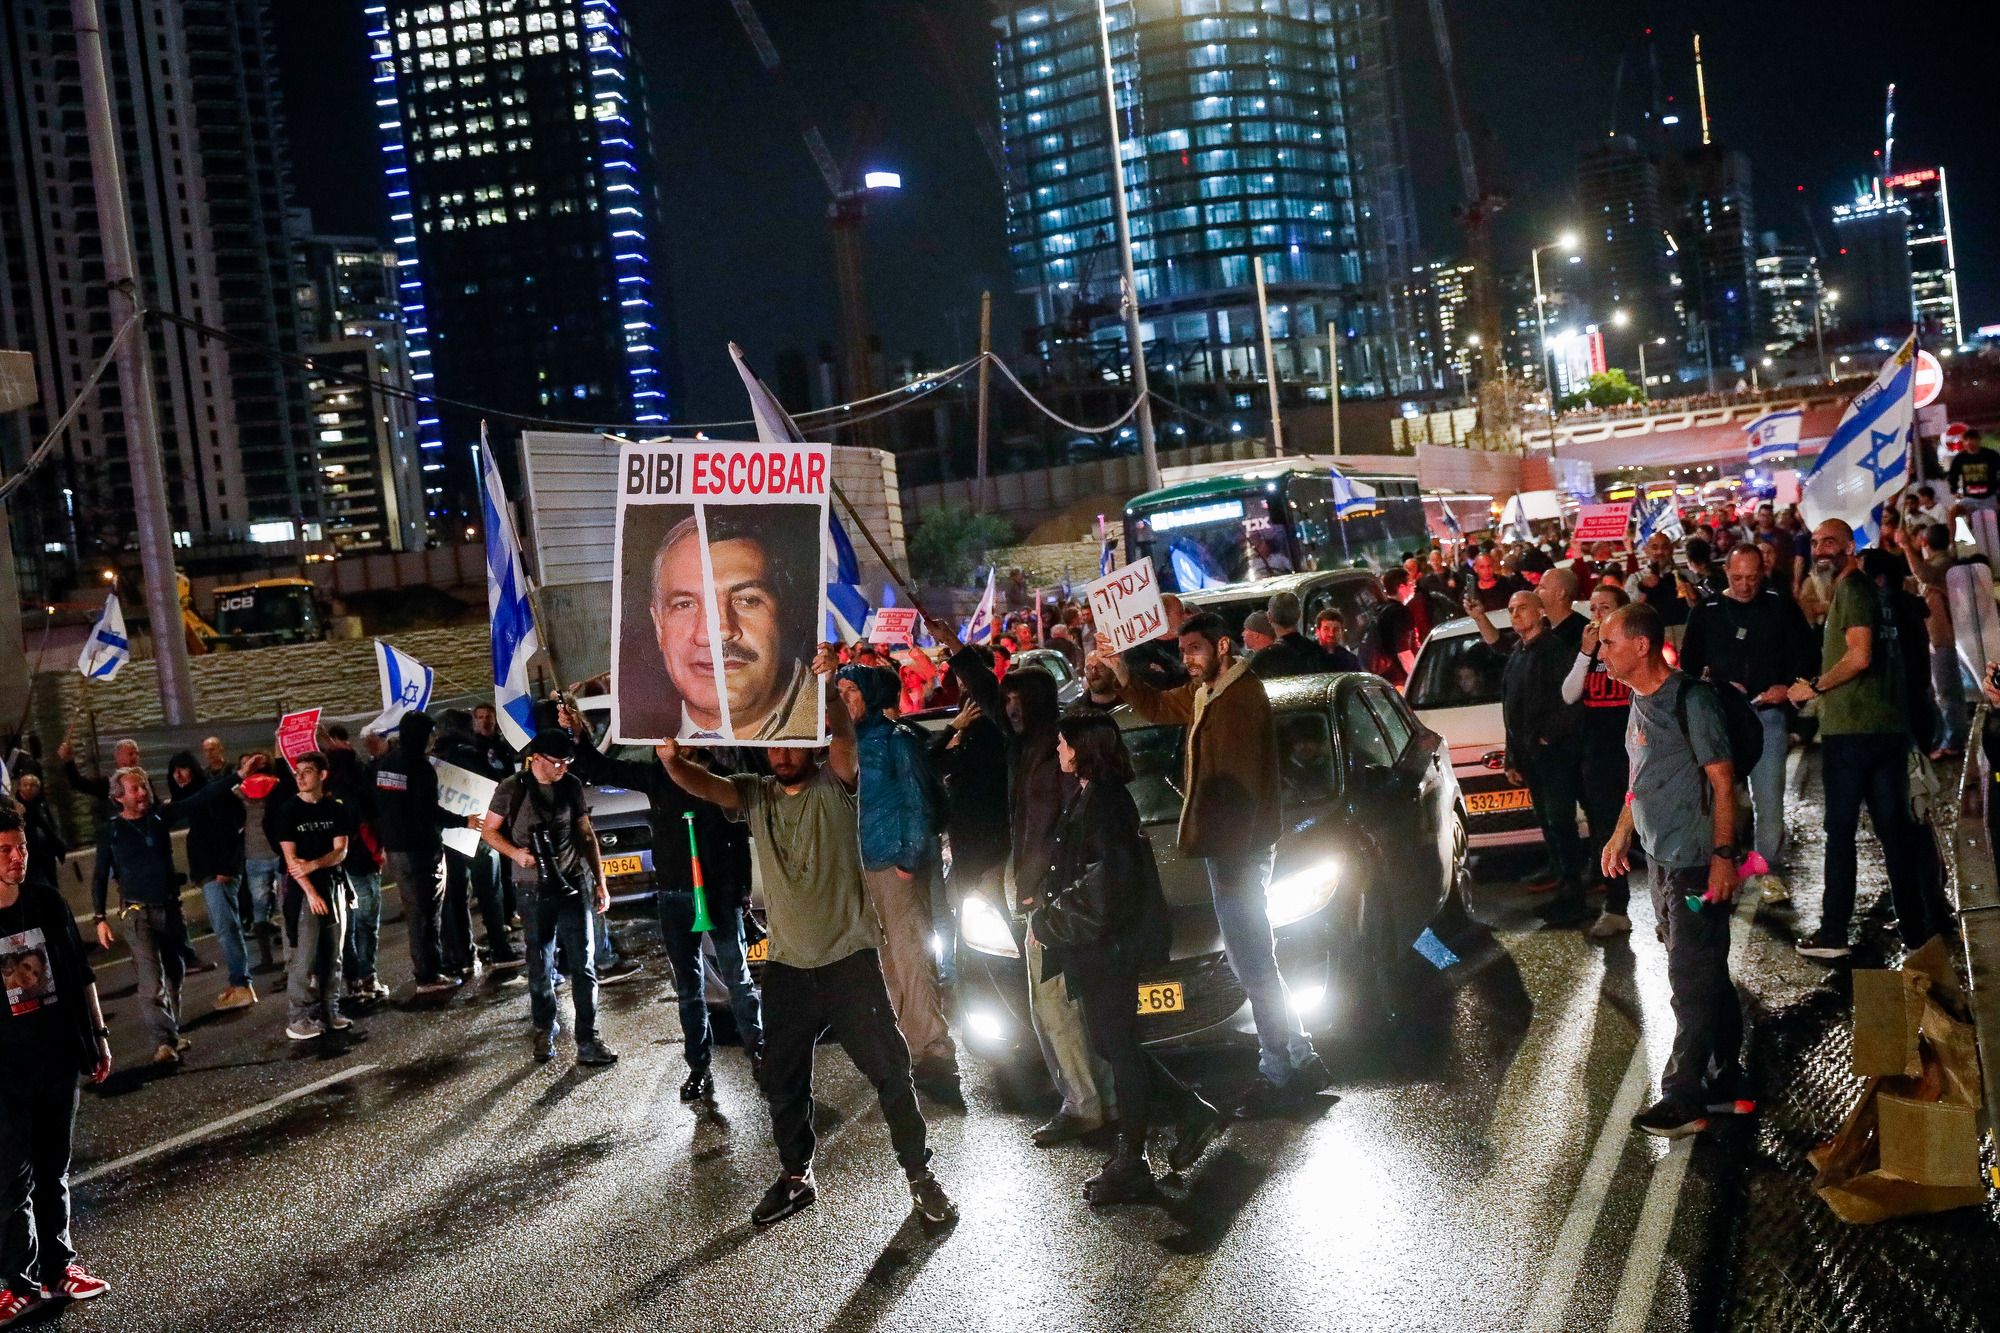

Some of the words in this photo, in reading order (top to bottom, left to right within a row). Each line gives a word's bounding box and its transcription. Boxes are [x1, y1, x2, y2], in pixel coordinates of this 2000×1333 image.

[626, 453, 683, 495] BIBI
[692, 452, 826, 495] ESCOBAR
[221, 596, 254, 612] JCB
[1093, 564, 1151, 620] עסקה
